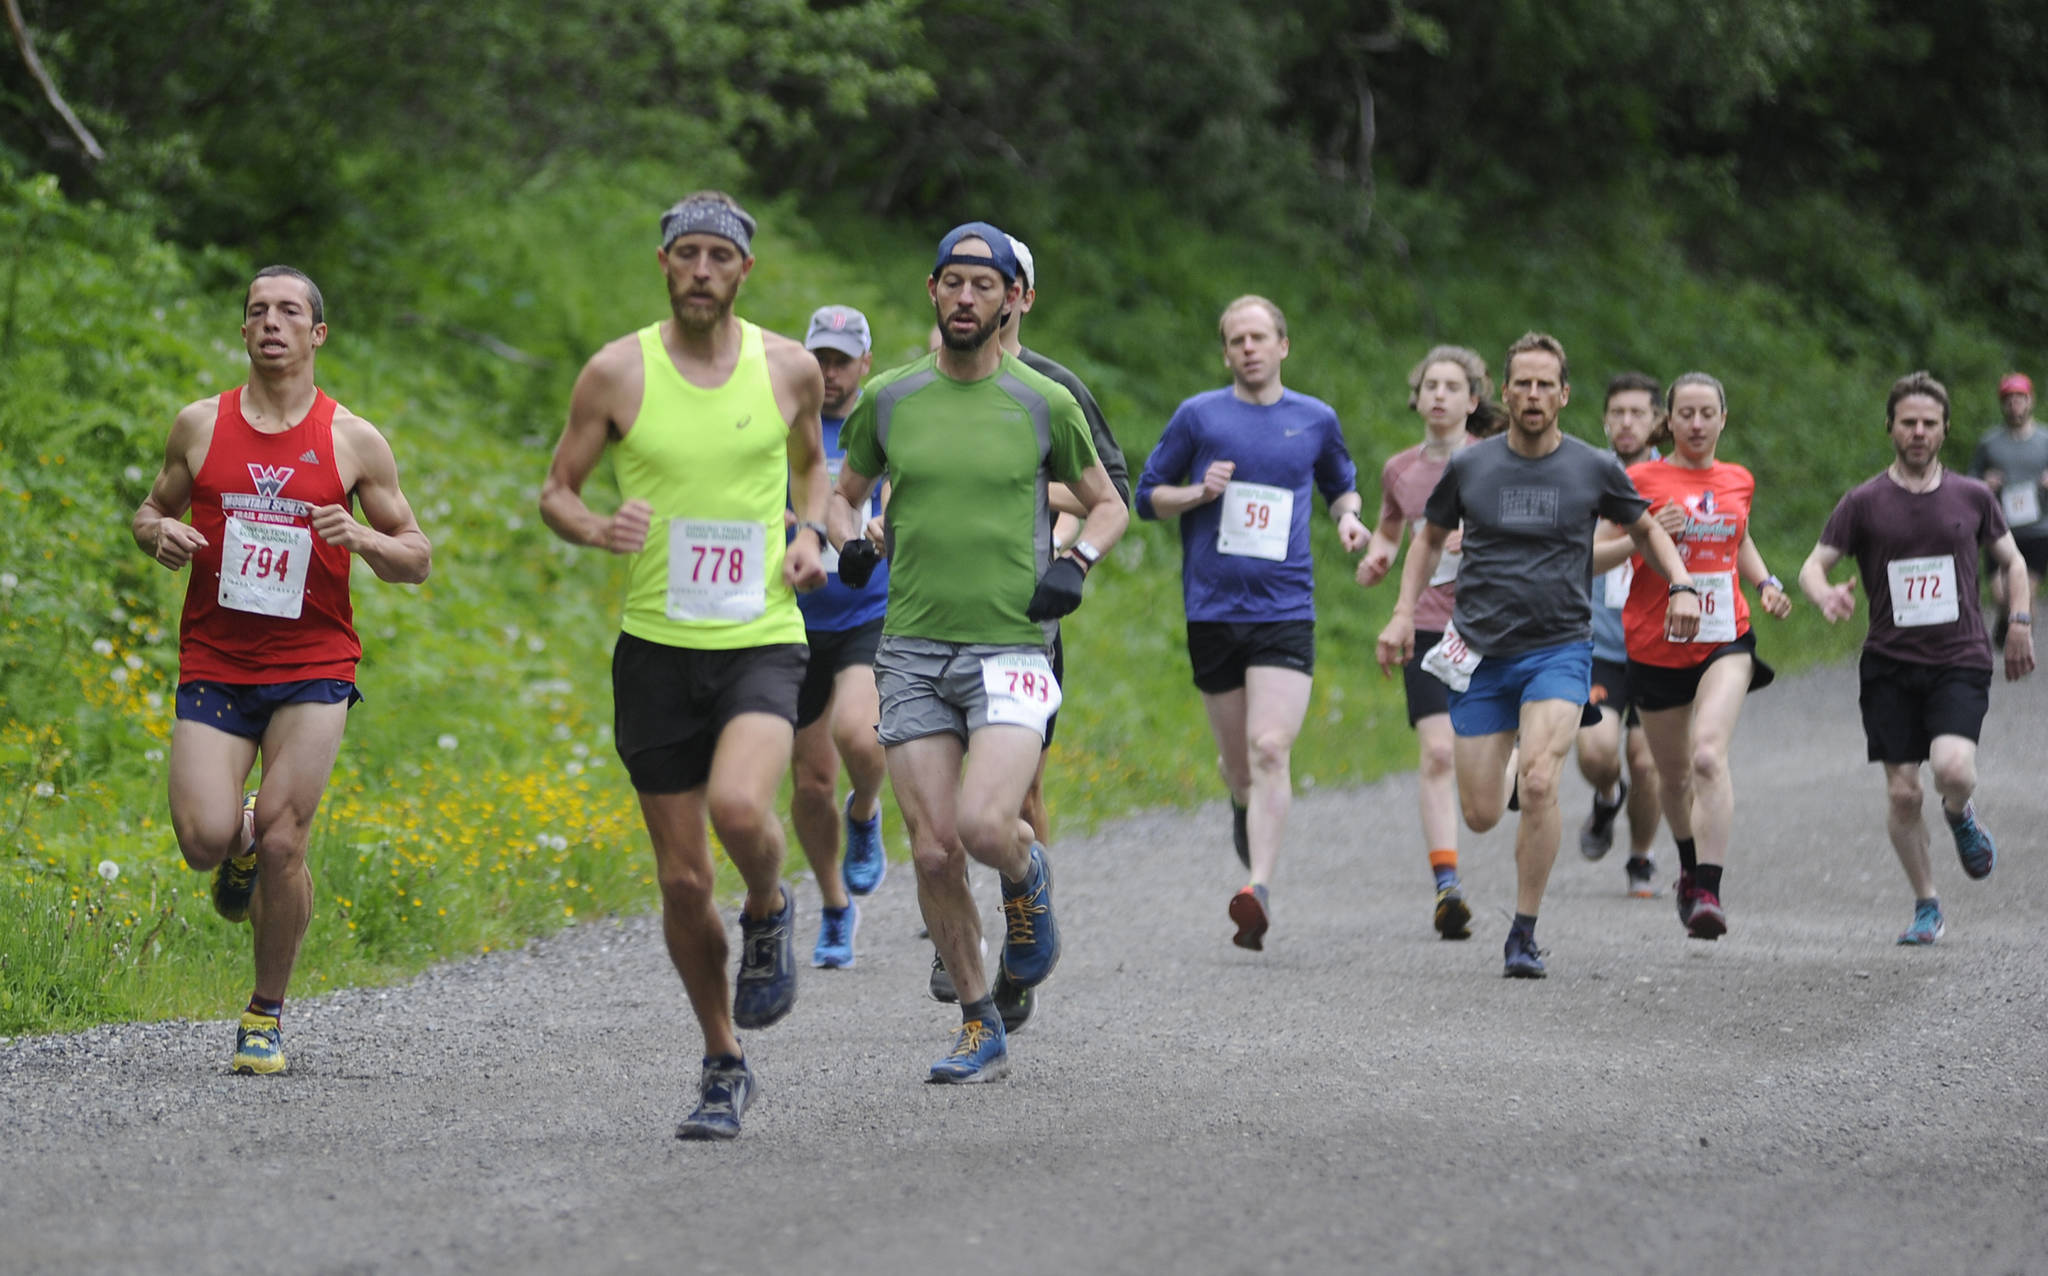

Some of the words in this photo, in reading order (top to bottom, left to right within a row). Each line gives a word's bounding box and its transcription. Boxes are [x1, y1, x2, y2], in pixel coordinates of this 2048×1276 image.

[257, 512, 294, 524] RUNNING
[1244, 502, 1269, 529] 59
[241, 544, 289, 582] 794
[692, 546, 744, 583] 778
[1904, 575, 1941, 601] 772
[1005, 671, 1049, 703] 783
